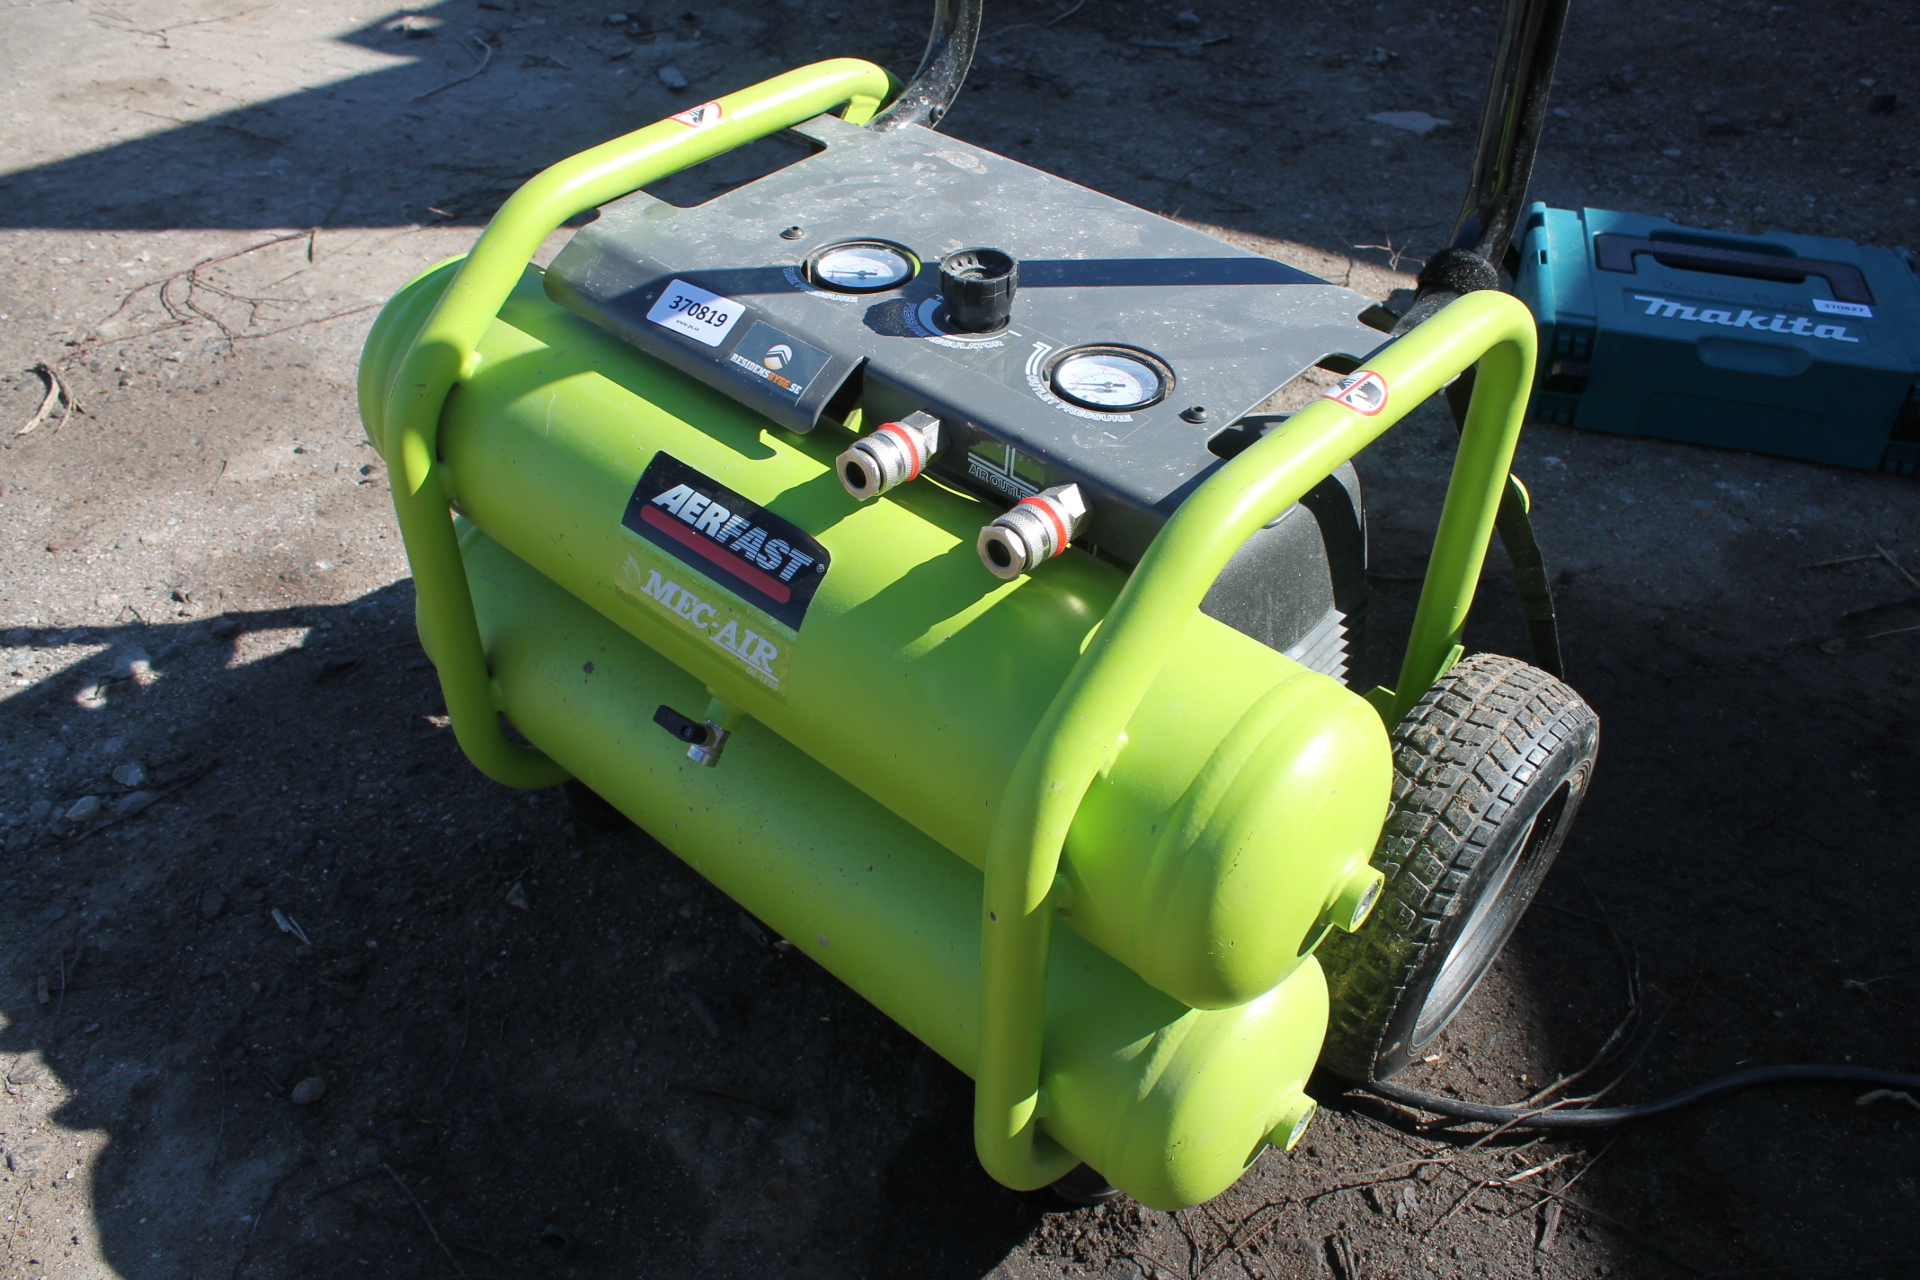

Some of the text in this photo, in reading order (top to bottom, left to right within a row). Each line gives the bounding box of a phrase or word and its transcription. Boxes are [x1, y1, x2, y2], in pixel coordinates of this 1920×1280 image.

[782, 266, 859, 303] TANK PRESSURE
[668, 295, 728, 328] 370819
[903, 302, 1005, 350] PRESSURE REGULATOR
[729, 352, 803, 395] RESIDENSBYGG.SE
[1026, 375, 1060, 406] OUTLET
[1056, 401, 1134, 423] PRESSURE
[968, 463, 1037, 502] AIR OUTLE
[651, 483, 814, 582] AERFAST
[640, 568, 781, 674] MEC-AIR
[745, 665, 780, 692] OIL-LESS
